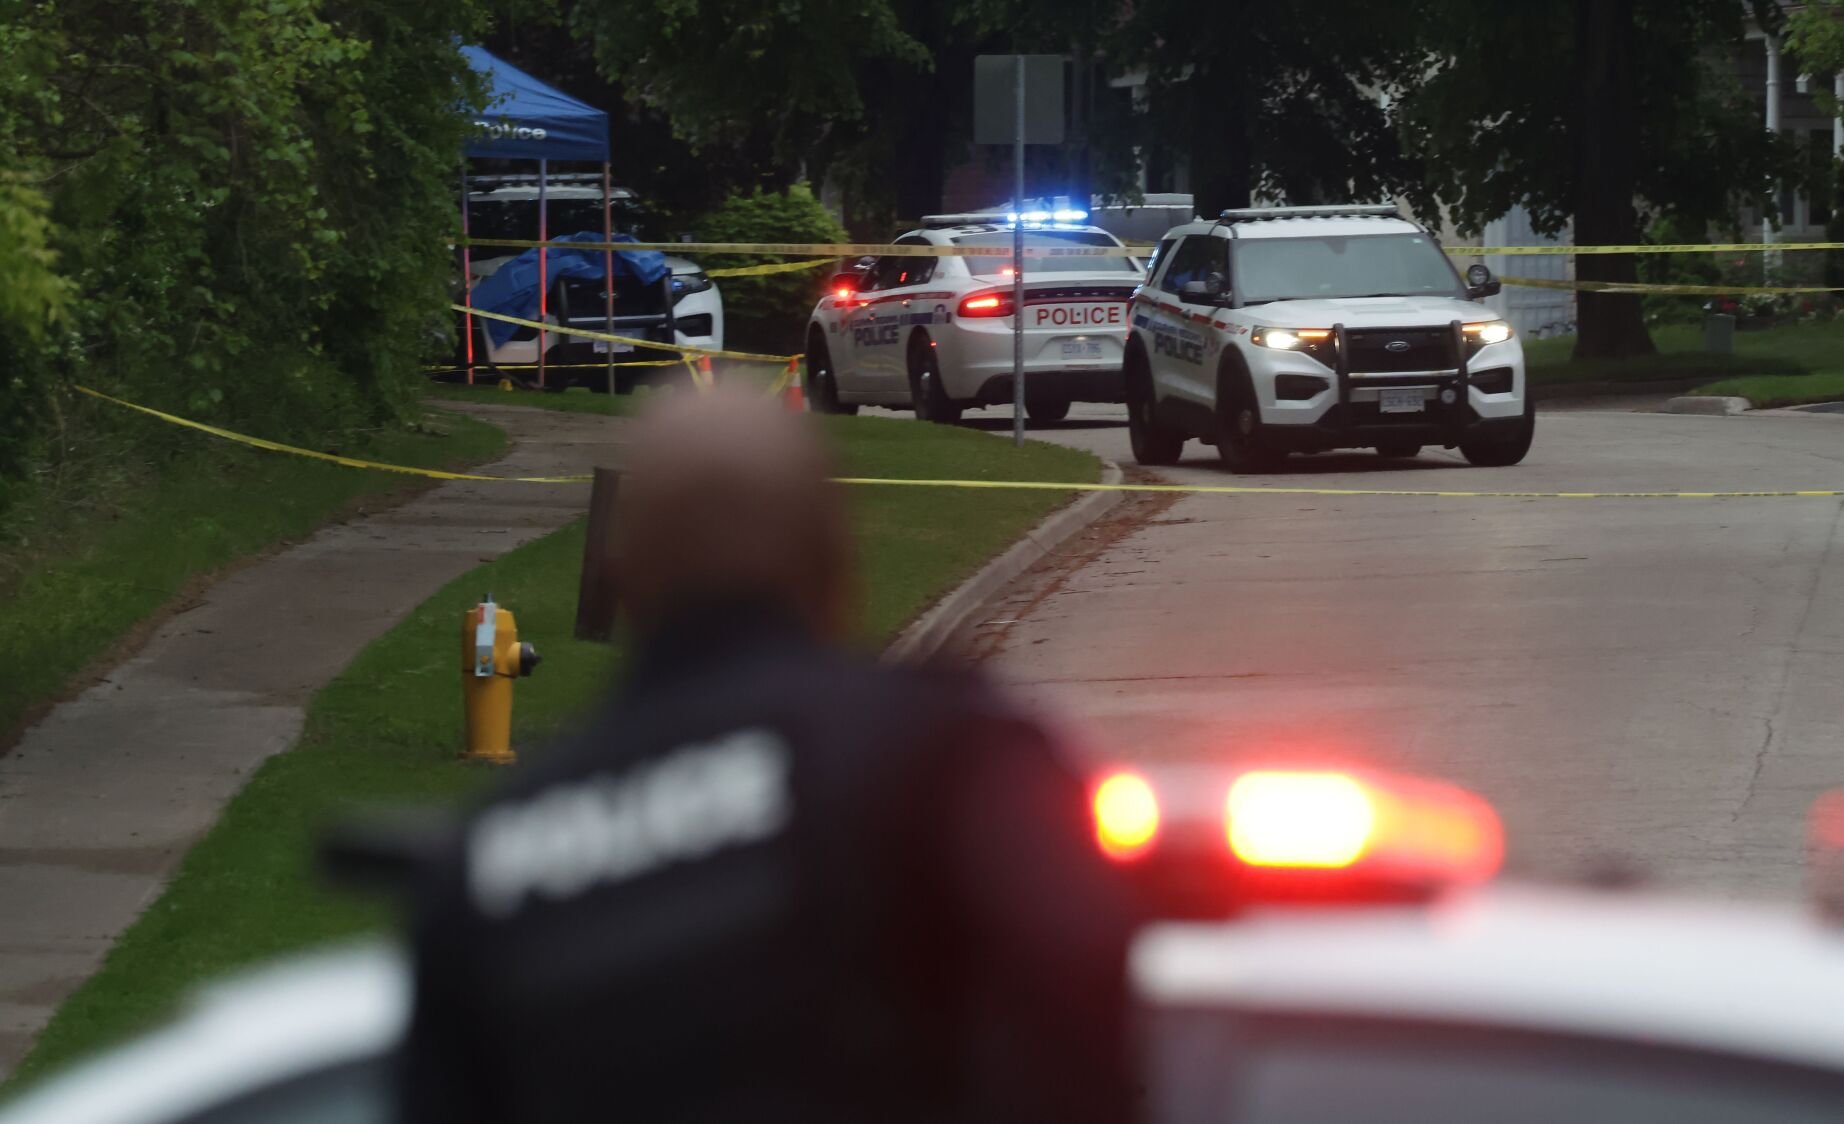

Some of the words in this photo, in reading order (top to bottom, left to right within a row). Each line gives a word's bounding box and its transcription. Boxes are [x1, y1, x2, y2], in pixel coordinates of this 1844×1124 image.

[1036, 306, 1121, 326] POLICE
[854, 324, 900, 347] POLICE
[1153, 330, 1204, 367] POLICE
